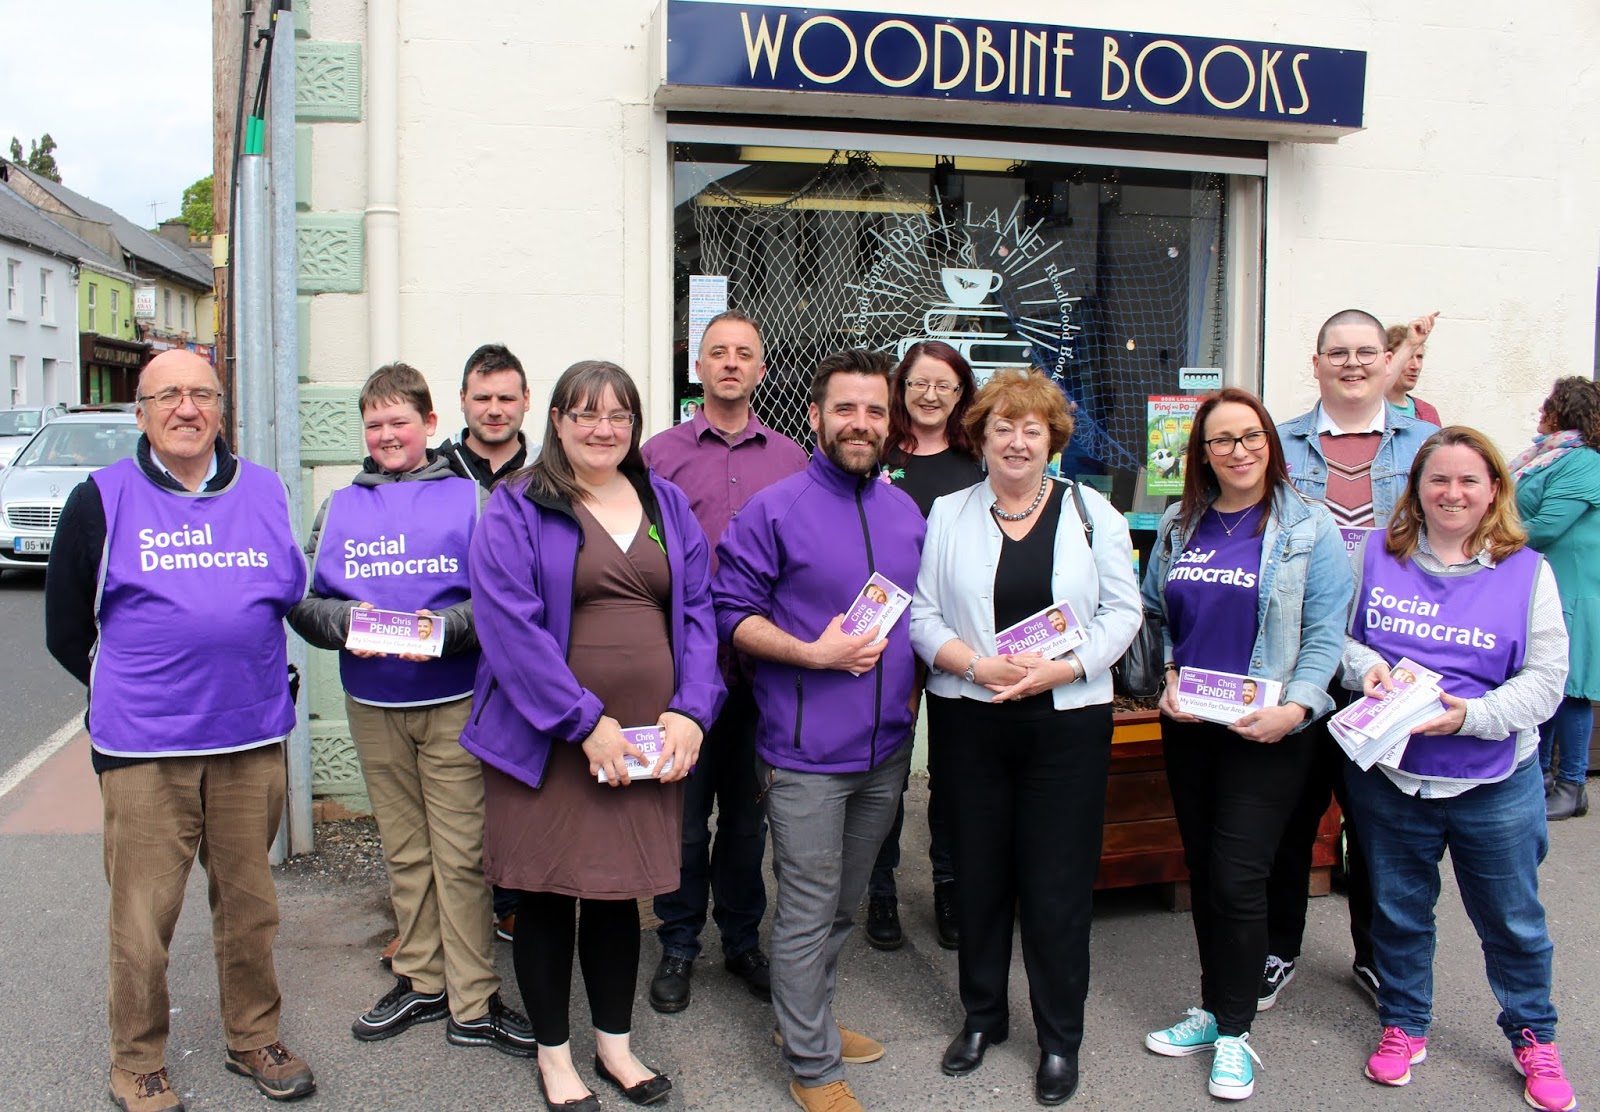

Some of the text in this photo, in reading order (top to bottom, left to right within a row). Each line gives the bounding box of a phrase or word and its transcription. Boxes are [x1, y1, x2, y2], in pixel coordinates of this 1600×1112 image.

[740, 12, 1310, 115] WOODBINE BOOKS
[889, 201, 1045, 259] BELL LANE
[854, 296, 870, 335] Good
[862, 253, 894, 292] Coffee
[1043, 262, 1069, 300] Read
[1060, 302, 1074, 341] Good
[1154, 403, 1171, 414] Ping
[138, 523, 213, 549] Social
[344, 534, 406, 559] Social
[1347, 532, 1364, 540] Chri
[141, 547, 269, 572] Democrats
[344, 554, 459, 580] Democrats
[1167, 566, 1257, 588] emocrats
[850, 603, 867, 622] Chris
[881, 605, 894, 619] Area
[1368, 586, 1440, 618] Social
[369, 623, 412, 637] PENDER
[391, 616, 412, 626] Chris
[850, 607, 877, 636] ENDER
[1023, 621, 1044, 635] Chris
[1366, 607, 1497, 650] Democrats
[1008, 628, 1050, 654] PENDER
[1052, 637, 1067, 647] Area
[1196, 685, 1236, 700] PENDER
[1217, 679, 1237, 689] Chris
[1180, 697, 1189, 705] My
[1190, 699, 1208, 707] Vision
[1367, 686, 1402, 718] PENDER
[635, 732, 655, 742] Chris
